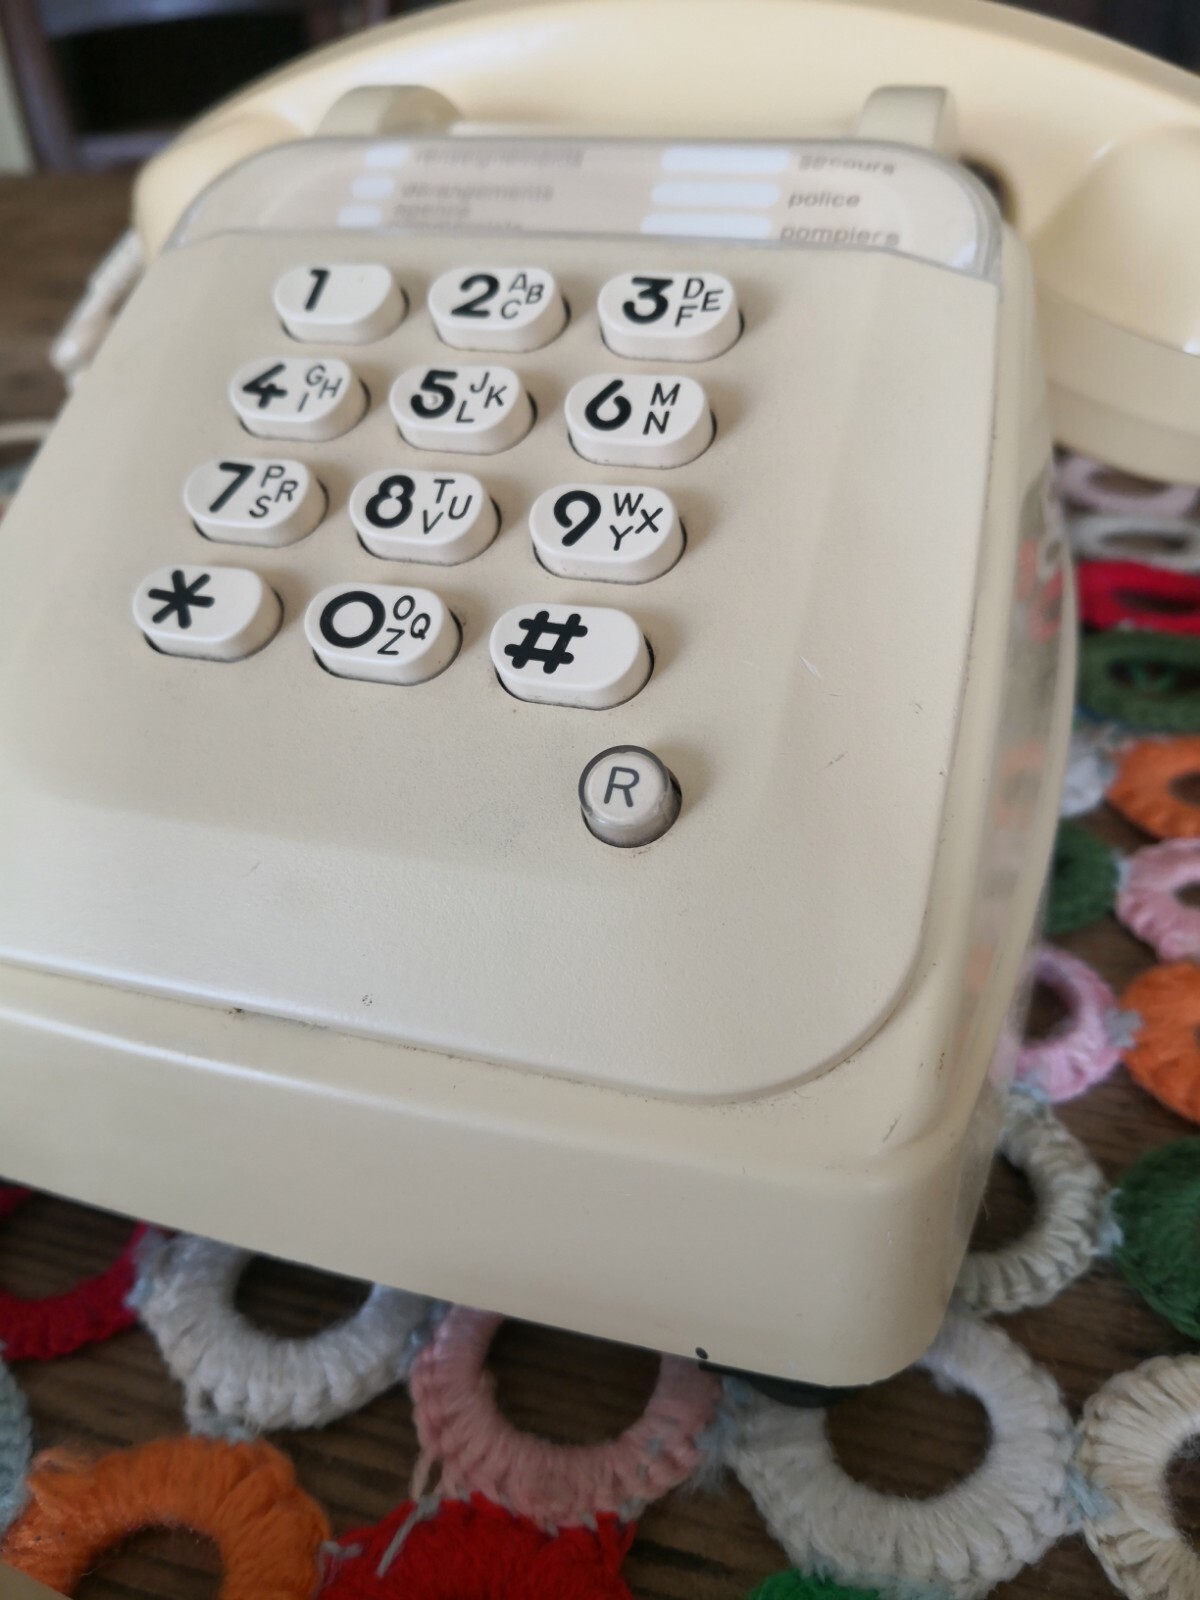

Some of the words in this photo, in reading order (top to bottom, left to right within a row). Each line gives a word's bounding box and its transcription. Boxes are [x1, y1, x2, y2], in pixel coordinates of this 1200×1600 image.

[787, 190, 861, 209] police
[779, 226, 901, 246] pompiers
[304, 268, 330, 312] 1
[451, 273, 500, 318] 2
[622, 276, 674, 325] 3
[242, 363, 288, 409] 4
[410, 369, 458, 419] 5
[584, 379, 632, 432] 6
[209, 461, 256, 513] 7
[365, 474, 416, 529] 8
[553, 490, 602, 547] 9
[603, 766, 640, 808] R
